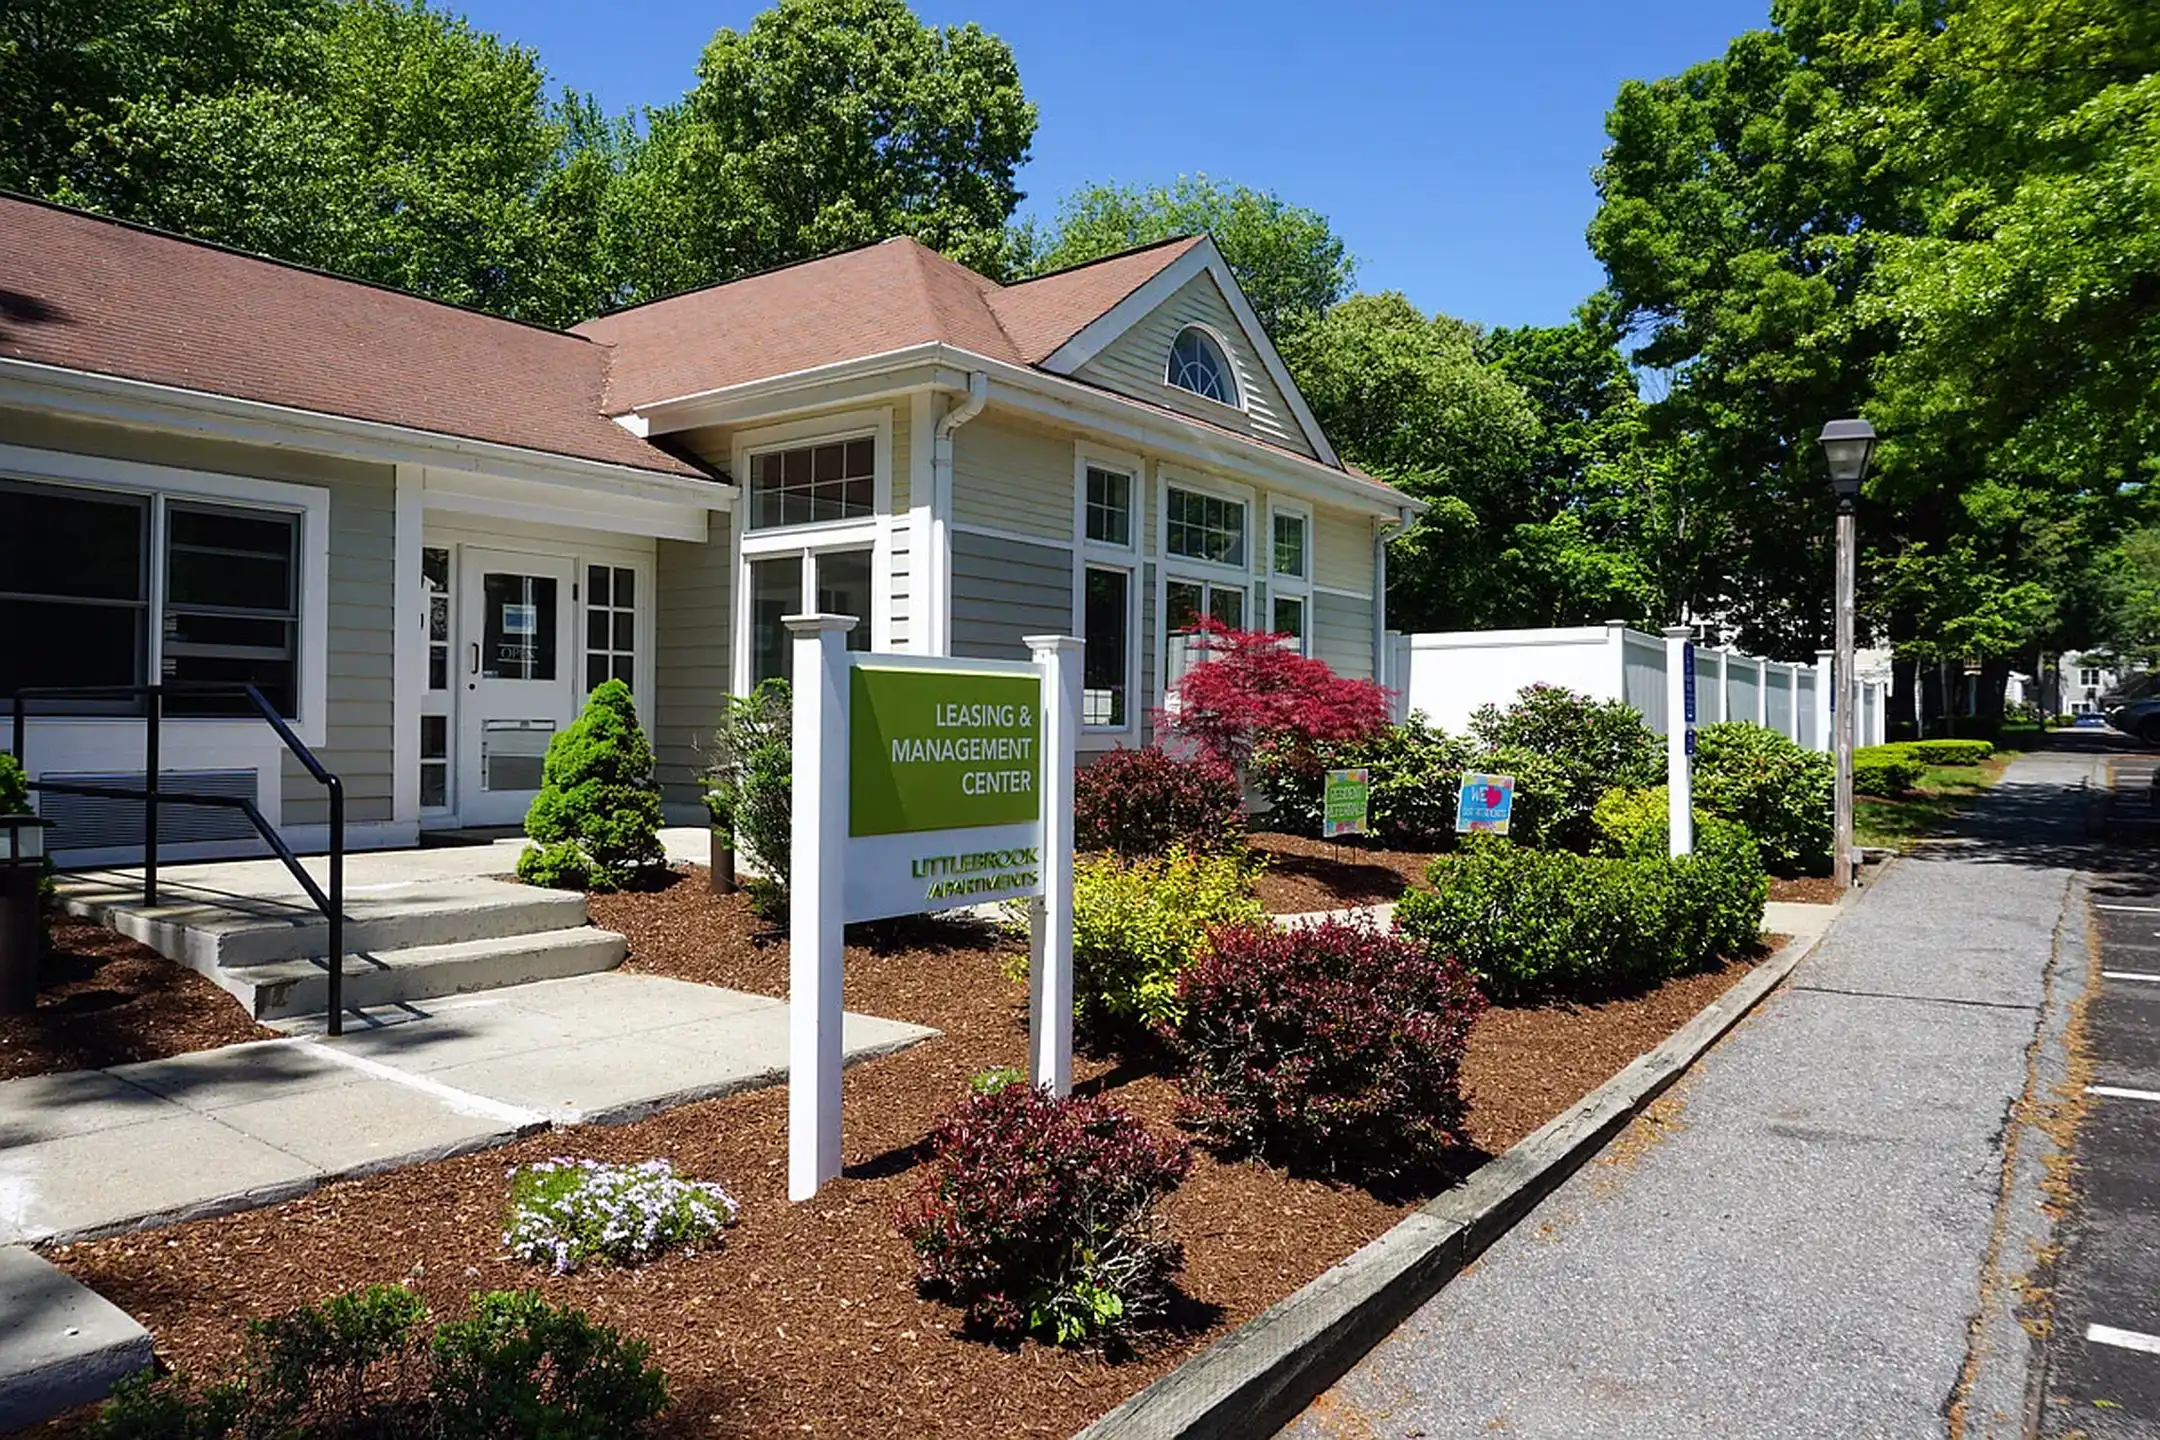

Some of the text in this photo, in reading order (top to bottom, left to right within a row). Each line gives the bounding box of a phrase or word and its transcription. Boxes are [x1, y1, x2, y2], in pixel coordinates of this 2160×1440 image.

[936, 703, 1032, 728] LEASING &
[891, 737, 1032, 763] MANAGEMENT
[961, 770, 1031, 796] CENTER
[1471, 786, 1488, 803] WE
[912, 847, 1039, 879] LITTLEBROOK
[926, 870, 1039, 901] APARTMENTS
